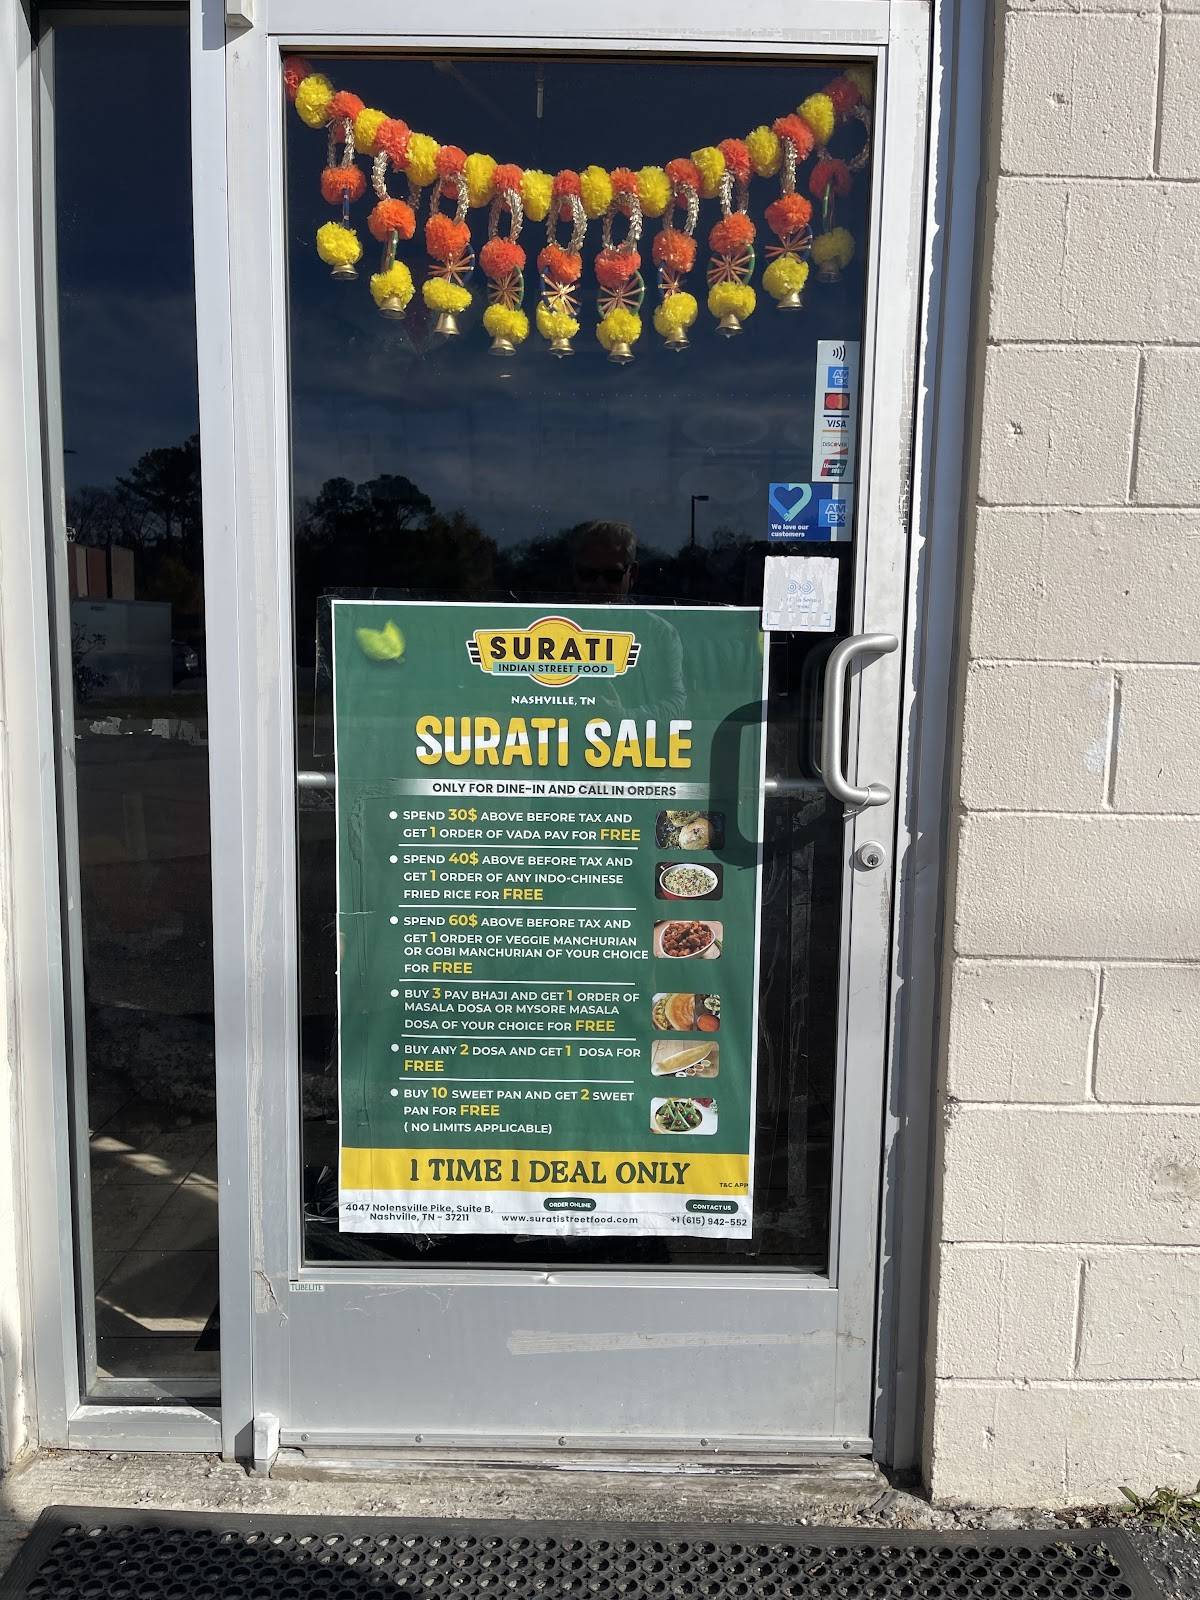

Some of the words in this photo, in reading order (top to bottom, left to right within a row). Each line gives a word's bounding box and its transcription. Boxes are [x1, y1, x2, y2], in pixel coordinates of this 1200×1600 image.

[825, 504, 846, 514] AM
[490, 636, 613, 661] SURATI
[498, 664, 534, 672] INDIAN
[538, 664, 573, 672] STREET
[578, 665, 608, 673] FOOD
[511, 696, 577, 705] NASHVILLE,
[580, 697, 596, 705] TN
[416, 715, 569, 767] SURATI
[584, 719, 692, 769] SALE
[432, 783, 466, 794] ONLY
[469, 783, 494, 794] FOR
[497, 784, 545, 794] DINE-IN
[549, 784, 576, 795] AND
[579, 785, 608, 796] CALL
[611, 785, 624, 796] IN
[627, 786, 676, 796] ORDERS
[403, 811, 445, 821] SPEND
[448, 808, 478, 823] 30$
[481, 812, 524, 822] ABOVE
[527, 812, 575, 822] BEFORE
[579, 813, 601, 823] TAX
[605, 814, 632, 823] AND
[403, 828, 427, 838] GET
[430, 827, 436, 838] 1
[440, 829, 482, 839] ORDER
[486, 830, 503, 839] OF
[507, 830, 541, 839] VADA
[544, 831, 569, 839] PAV
[572, 831, 597, 840] FOR
[600, 828, 641, 841] FREE
[403, 854, 445, 864] SPEND
[448, 852, 479, 866] 40$
[482, 856, 525, 865] ABOVE
[528, 856, 576, 866] BEFORE
[580, 857, 602, 866] TAX
[606, 857, 633, 866] AND
[403, 872, 427, 882] GET
[430, 870, 436, 881] 1
[440, 873, 482, 882] ORDER
[486, 873, 503, 882] OF
[506, 874, 531, 883] ANY
[534, 874, 623, 884] INDO-CHINESE
[404, 890, 440, 899] FRIED
[443, 890, 471, 899] RICE
[474, 890, 499, 900] FOR
[503, 888, 544, 901] FREE
[404, 917, 445, 926] SPEND
[449, 914, 478, 928] 60$
[481, 918, 524, 927] ABOVE
[527, 918, 575, 928] BEFORE
[578, 919, 600, 928] TAX
[604, 919, 631, 928] AND
[404, 934, 427, 943] GET
[430, 932, 436, 943] 1
[440, 935, 482, 944] ORDER
[486, 935, 502, 944] OF
[506, 935, 550, 945] VEGGIE
[553, 936, 636, 946] MANCHURIAN
[404, 947, 422, 956] OR
[425, 947, 456, 956] GOBI
[459, 948, 542, 958] MANCHURIAN
[546, 949, 563, 958] OF
[566, 949, 599, 959] YOUR
[602, 950, 649, 960] CHOICE
[404, 963, 429, 973] FOR
[432, 962, 473, 974] FREE
[404, 989, 429, 998] BUY
[432, 988, 441, 999] 3
[444, 990, 469, 1000] PAV
[471, 991, 507, 1001] BHAJI
[511, 991, 538, 1001] AND
[541, 991, 564, 1001] GET
[567, 990, 573, 1001] 1
[577, 992, 620, 1002] ORDER
[623, 993, 640, 1002] OF
[404, 1003, 454, 1012] MASALA
[458, 1003, 492, 1013] DOSA
[495, 1004, 513, 1013] OR
[516, 1004, 566, 1014] MYSORE
[570, 1005, 619, 1015] MASALA
[404, 1019, 439, 1029] DOSA
[442, 1020, 458, 1030] OF
[461, 1021, 495, 1030] YOUR
[498, 1021, 544, 1031] CHOICE
[547, 1022, 572, 1031] FOR
[575, 1019, 615, 1032] FREE
[404, 1044, 429, 1054] BUY
[432, 1045, 457, 1055] ANY
[460, 1044, 468, 1055] 2
[472, 1047, 506, 1056] DOSA
[510, 1047, 537, 1056] AND
[539, 1047, 562, 1056] GET
[566, 1045, 571, 1056] 1
[580, 1048, 613, 1057] DOSA
[617, 1048, 641, 1057] FOR
[404, 1060, 444, 1072] FREE
[404, 1089, 429, 1098] BUY
[431, 1087, 447, 1099] 10
[451, 1090, 493, 1099] SWEET
[497, 1090, 522, 1100] PAN
[525, 1090, 552, 1100] AND
[555, 1091, 578, 1100] GET
[581, 1089, 589, 1100] 2
[593, 1092, 634, 1101] SWEET
[404, 1106, 429, 1115] PAN
[432, 1107, 457, 1116] FOR
[460, 1104, 500, 1116] FREE
[412, 1123, 430, 1132] NO
[433, 1123, 471, 1133] LIMITS
[474, 1123, 552, 1135] APPLICABLE)
[428, 1159, 502, 1182] TIME
[529, 1160, 606, 1183] DEAL
[616, 1161, 691, 1185] ONLY
[372, 1204, 428, 1212] Nolensville
[430, 1204, 453, 1213] Pike,
[484, 1206, 494, 1214] B,
[370, 1213, 420, 1222] Nashville,
[502, 1215, 638, 1224] www.suratistreetfood.com
[682, 1215, 705, 1226] (615)
